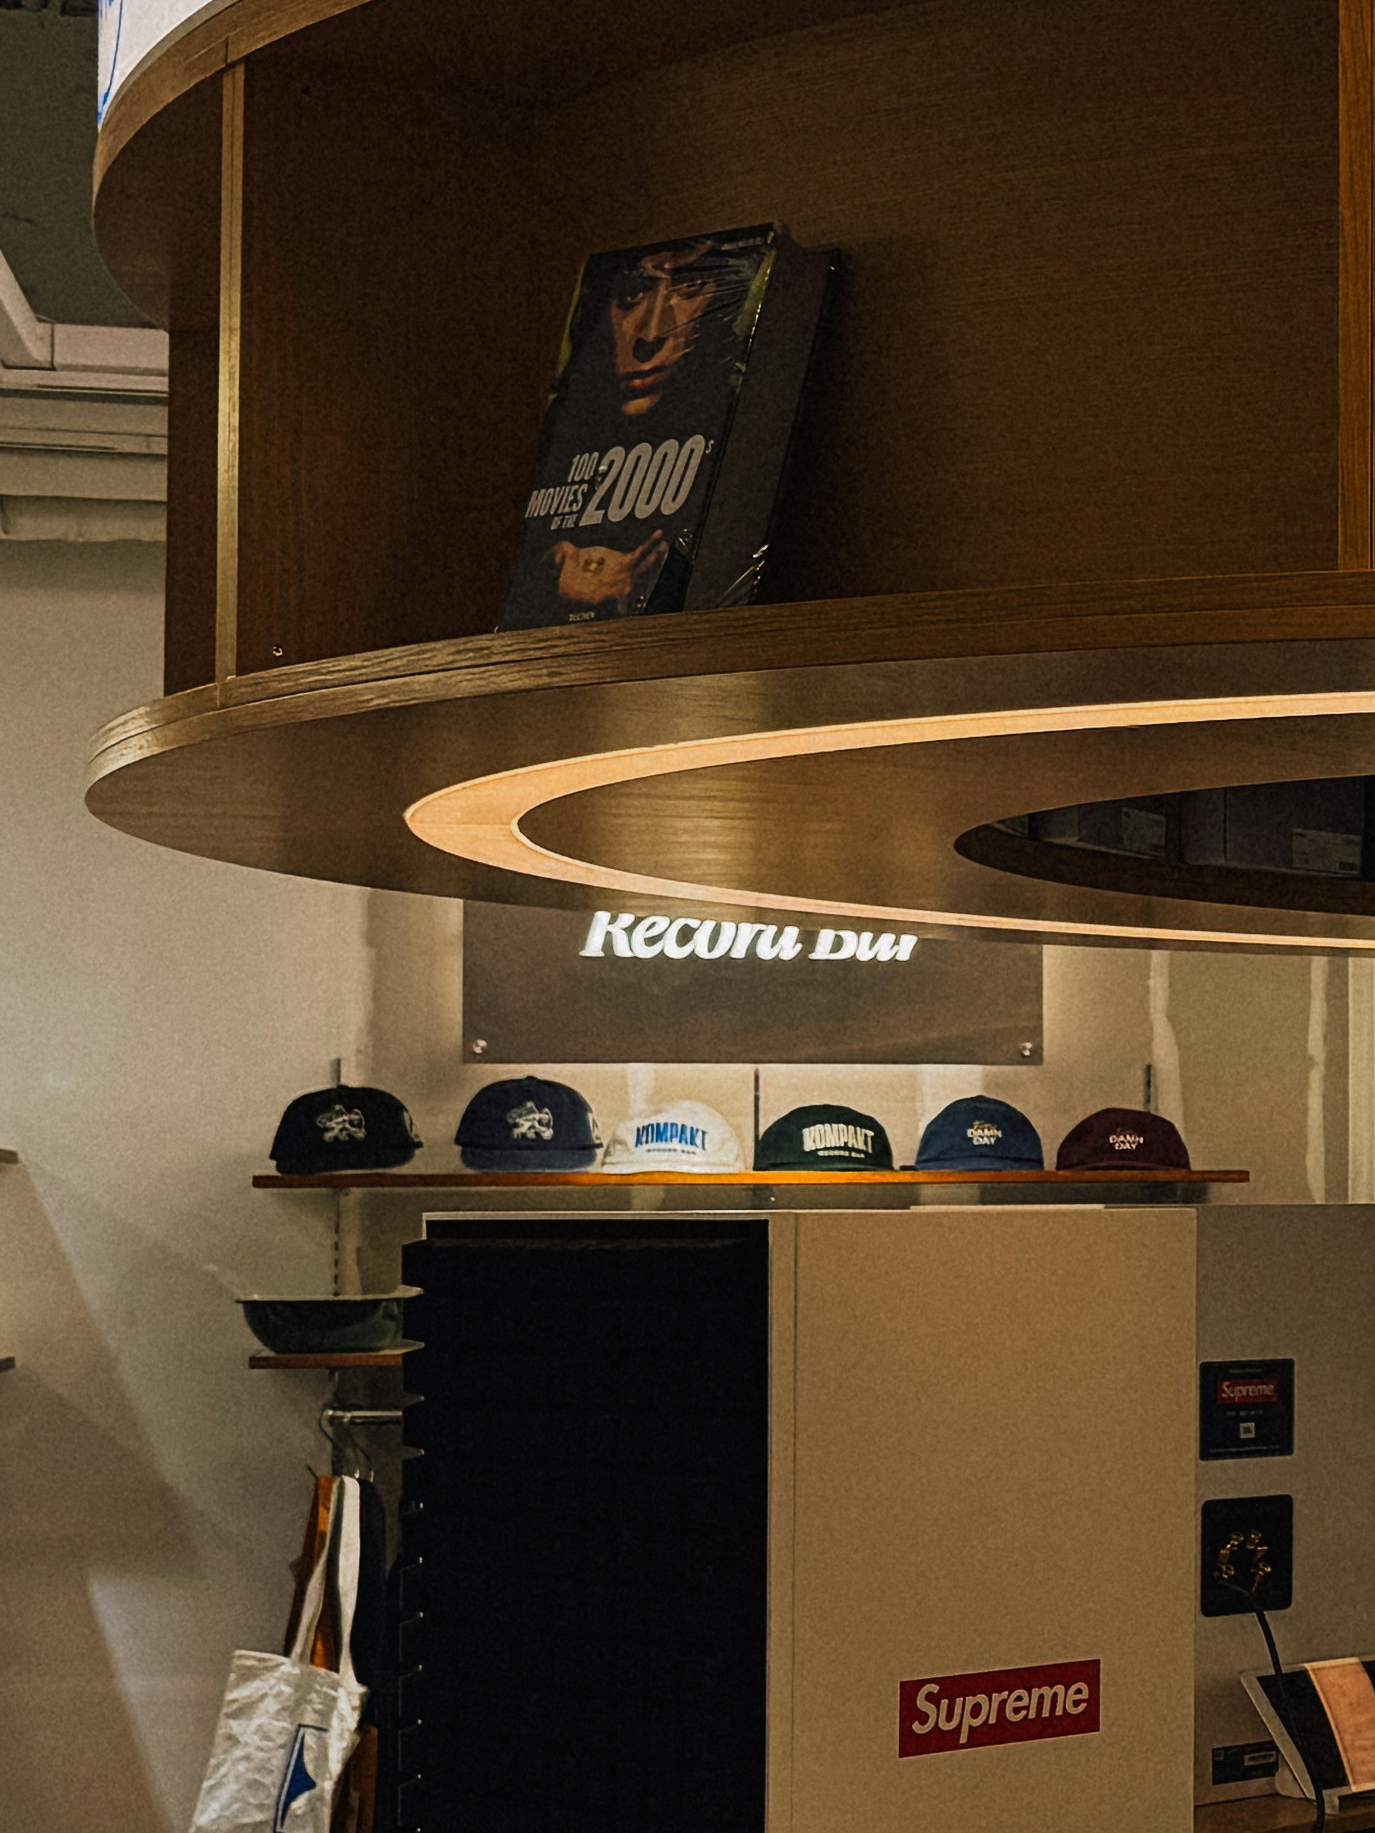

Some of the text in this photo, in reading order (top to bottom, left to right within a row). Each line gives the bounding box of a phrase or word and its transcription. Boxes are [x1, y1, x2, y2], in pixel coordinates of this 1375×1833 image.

[568, 451, 599, 483] 100
[525, 483, 588, 518] MOVIES
[634, 1122, 708, 1150] KOMPAKT
[802, 1122, 875, 1155] KOMPAKT
[1222, 1380, 1276, 1402] Supreme
[911, 1681, 1090, 1744] Supreme
